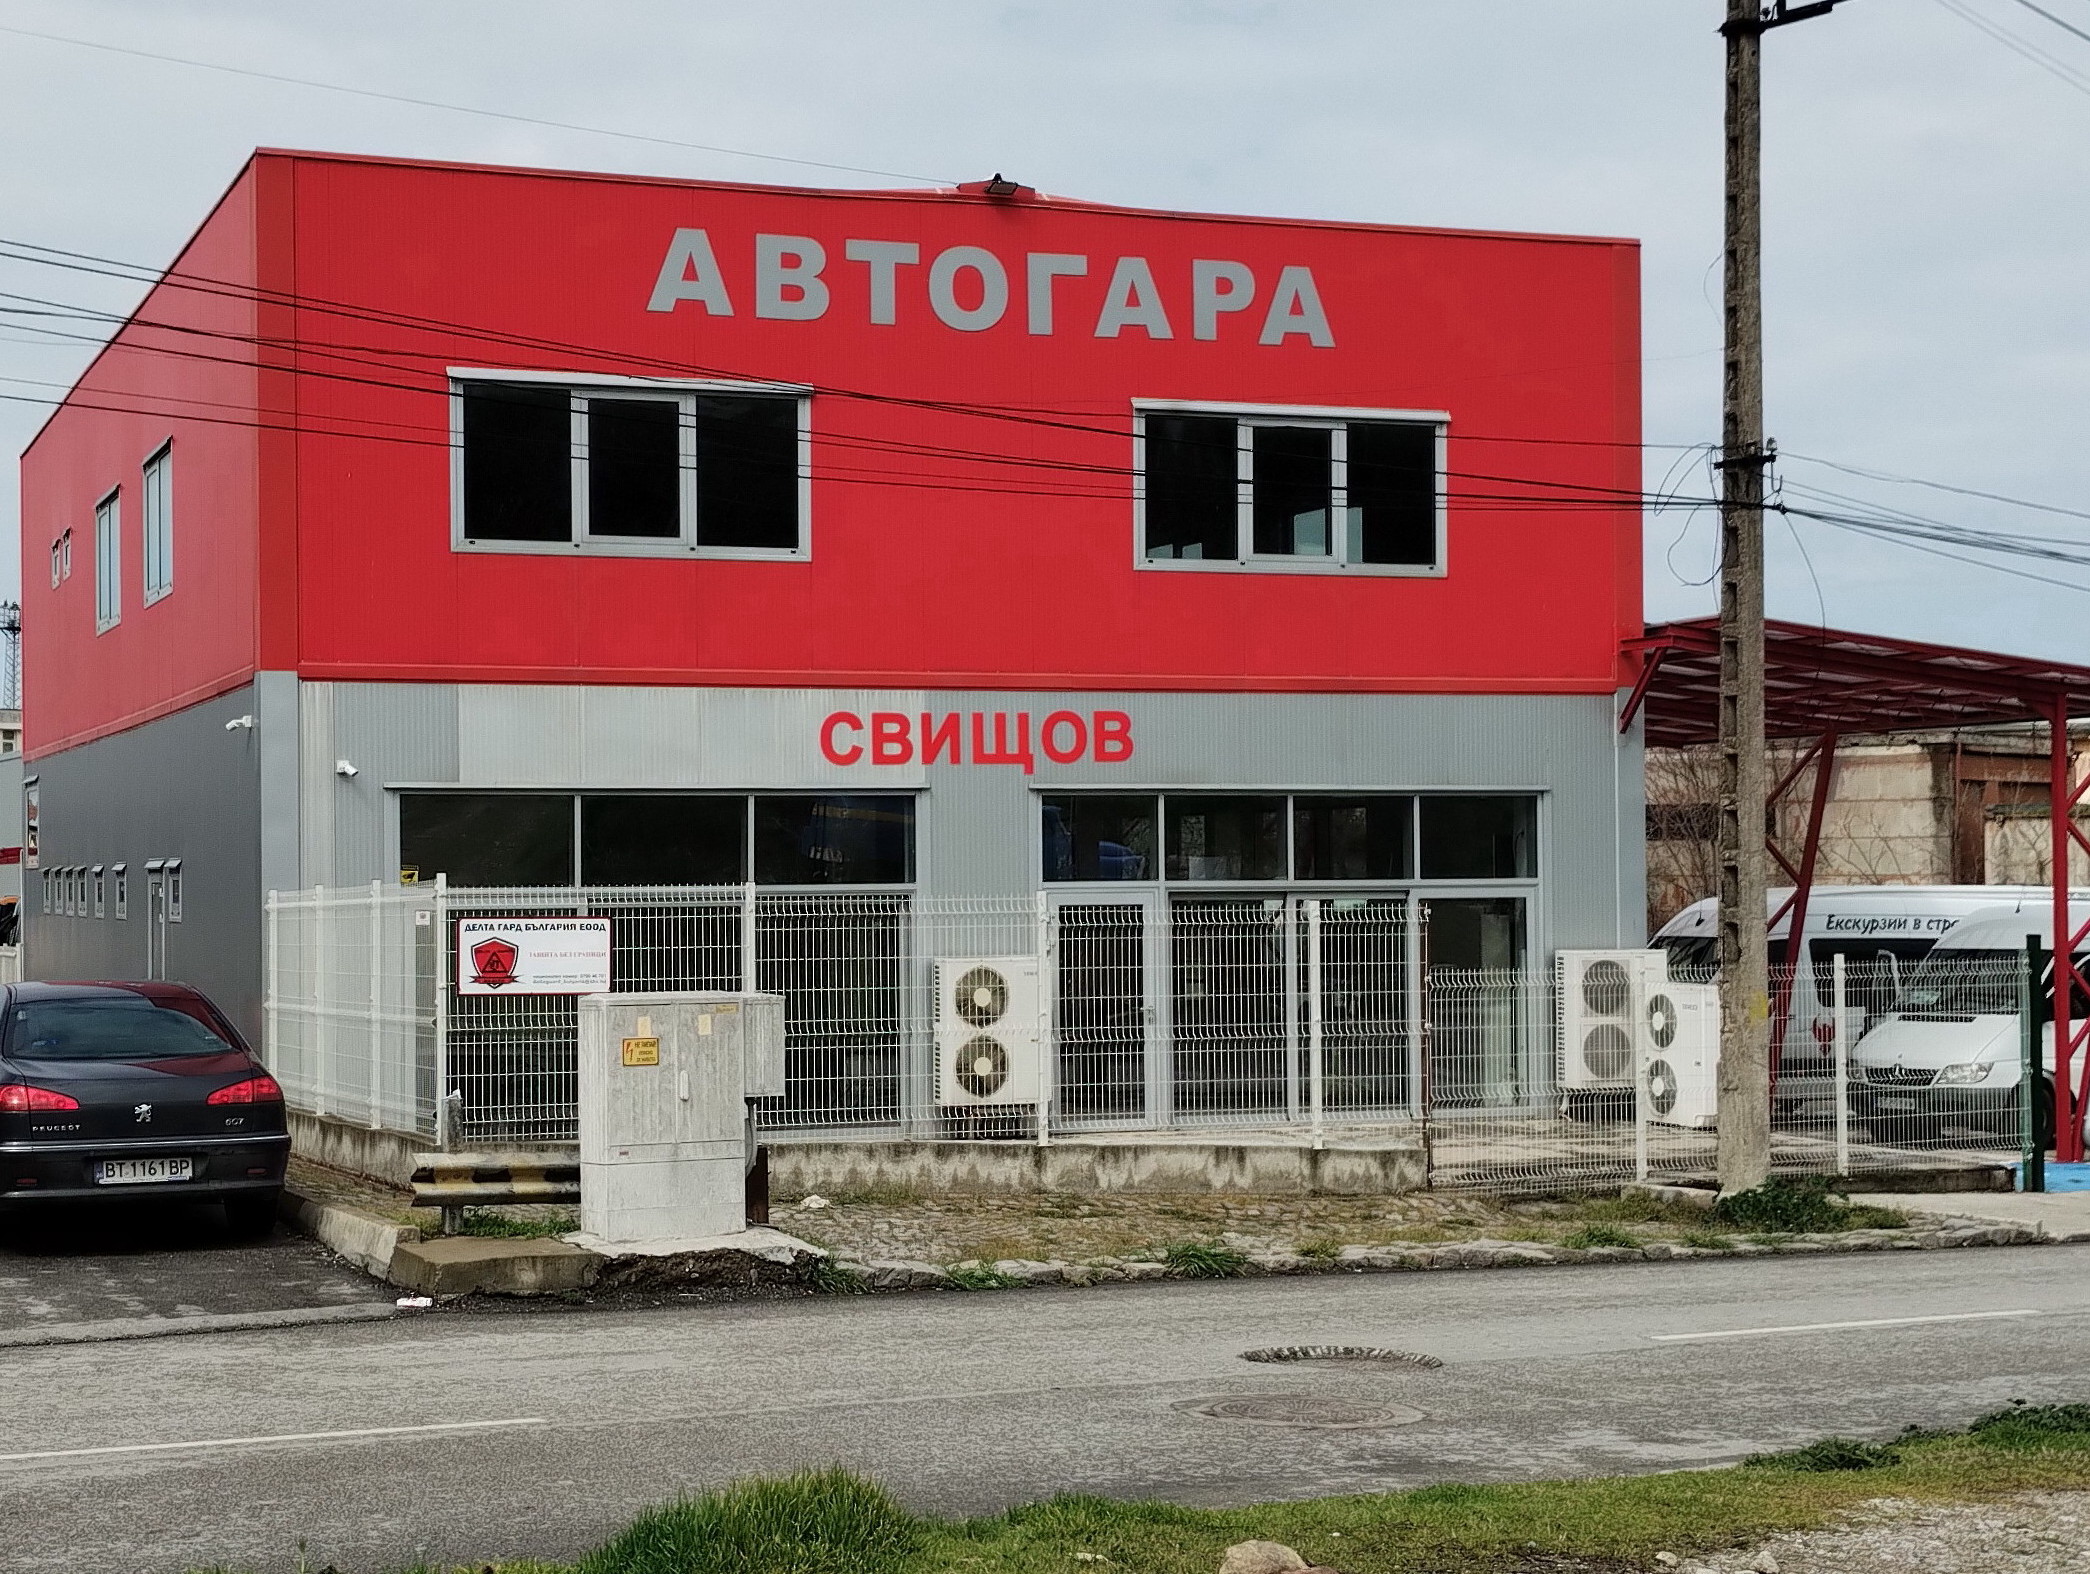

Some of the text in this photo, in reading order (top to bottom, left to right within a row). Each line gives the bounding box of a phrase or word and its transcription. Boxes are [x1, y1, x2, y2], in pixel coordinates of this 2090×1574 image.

[646, 227, 1336, 347] АВТОГАРА
[820, 711, 1134, 775] СВИЩОВ
[464, 923, 606, 932] ДЕЛТА ГАРД БЪЛГАРИЯ ЕООД
[1826, 914, 1907, 935] Екскурзии
[1913, 918, 1921, 930] в
[32, 1123, 81, 1132] PEUGEOT
[225, 1118, 244, 1126] 607
